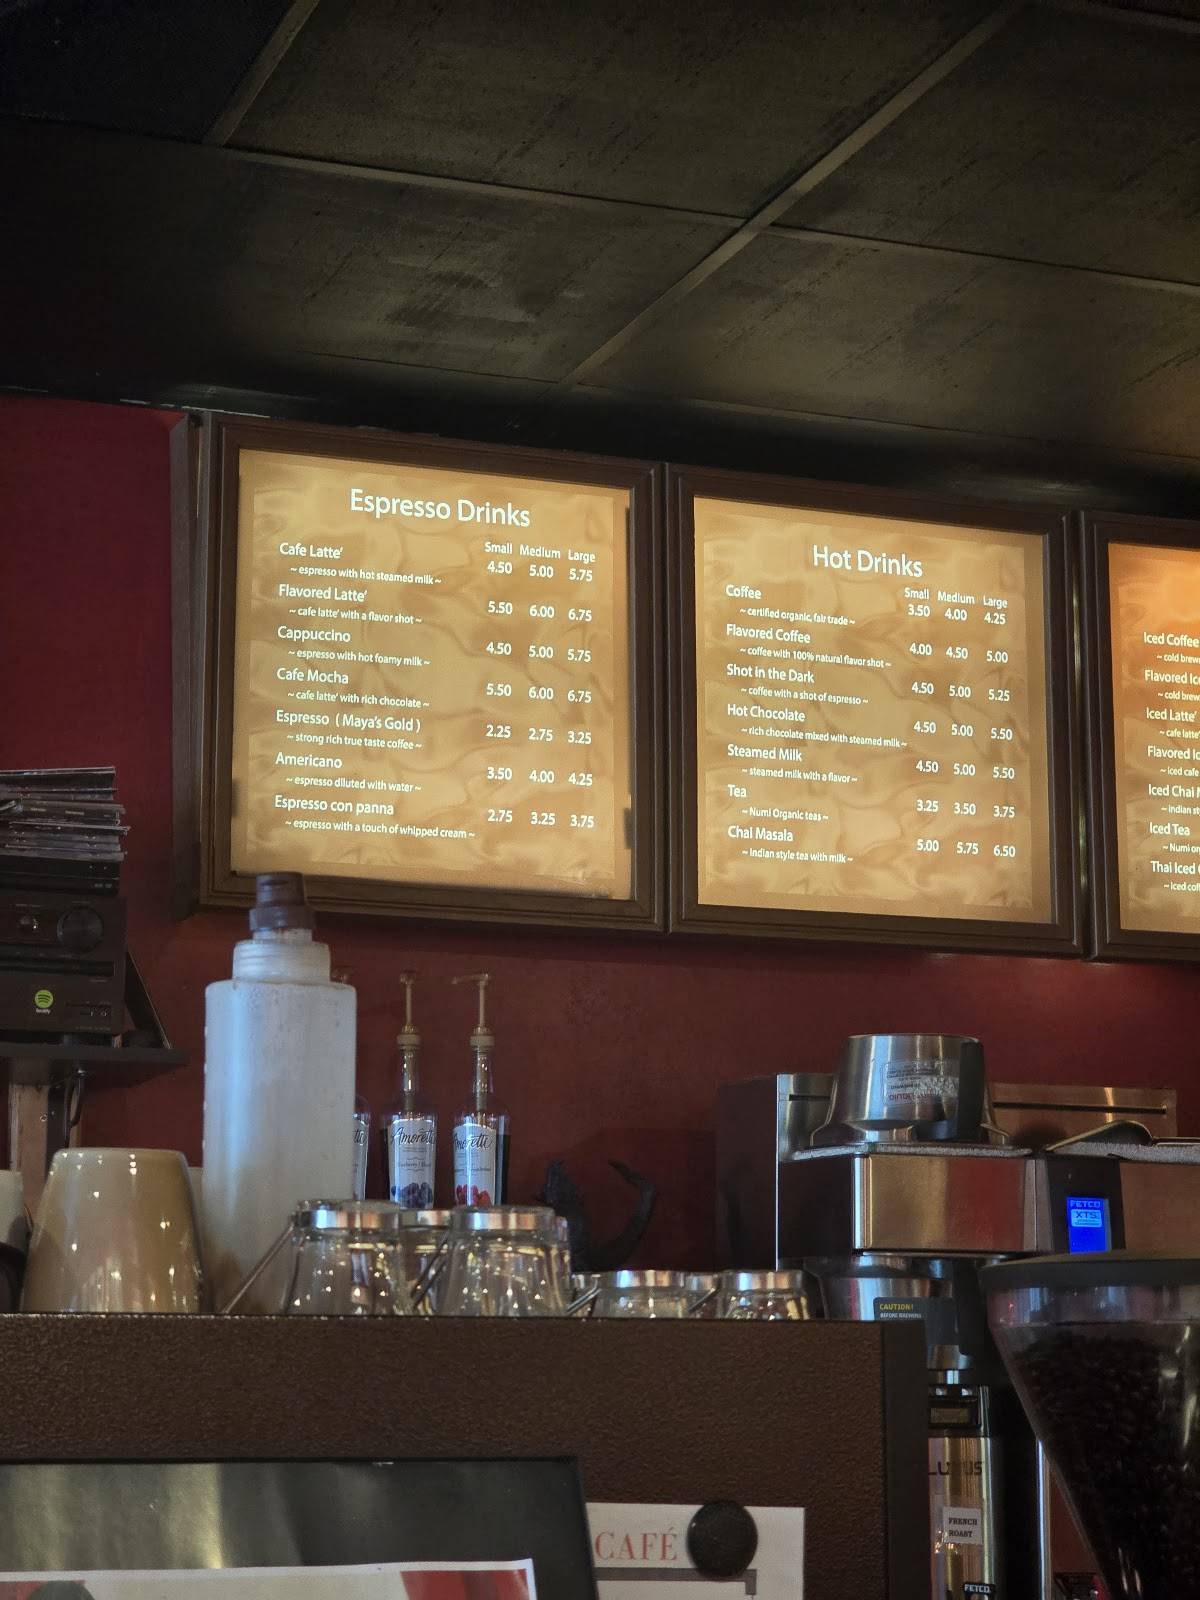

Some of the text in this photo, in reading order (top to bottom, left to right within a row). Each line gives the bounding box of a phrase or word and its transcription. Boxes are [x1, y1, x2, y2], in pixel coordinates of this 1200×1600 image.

[350, 488, 530, 527] Espresso Drinks
[279, 542, 307, 556] Cafe
[484, 541, 596, 564] Small Medium Large
[813, 544, 923, 578] Hot Drinks
[298, 566, 434, 585] espresso with hot steamed milk
[487, 560, 593, 582] 4.50 5.00 5.75
[278, 583, 332, 599] Flavored
[725, 584, 762, 600] Coffee
[904, 587, 1008, 609] Small Medium Large
[297, 606, 317, 617] cafe
[340, 610, 360, 620] with
[361, 612, 367, 621] a
[368, 611, 394, 623] flavor
[394, 613, 414, 625] shot
[488, 600, 592, 622] 5.50 6.00 6.75
[908, 604, 1006, 625] 3.50 4.00 4.25
[277, 625, 351, 643] Cappuccino
[726, 623, 811, 644] Flavored Coffee
[1143, 631, 1200, 648] Iced Coffee
[296, 650, 423, 667] espresso with hot foamy milk
[486, 641, 591, 662] 4.50 5.00 5.75
[793, 650, 815, 661] 100%
[909, 642, 1009, 663] 4.00 4.50 5.00
[276, 667, 349, 684] Cafe Mocha
[726, 663, 815, 683] Shot in the Dark
[1144, 669, 1188, 684] Flavored
[295, 690, 315, 700] cafe
[339, 693, 360, 703] with
[361, 694, 378, 705] rich
[378, 695, 422, 708] chocolate
[486, 683, 592, 704] 5.50 6.00 6.75
[911, 681, 1010, 702] 4.50 5.00 5.25
[276, 709, 330, 726] Espresso
[384, 717, 414, 732] Gold
[727, 703, 806, 722] Hot Chocolate
[1146, 707, 1167, 720] Iced
[486, 724, 592, 745] 2.25 2.75 3.25
[913, 721, 1013, 741] 4.50 5.00 5.50
[295, 733, 414, 750] strong rich true taste coffee
[275, 751, 343, 769] Americano
[727, 743, 802, 762] Steamed Milk
[1147, 745, 1191, 760] Flavored
[487, 766, 593, 787] 3.50 4.00 4.25
[915, 760, 1015, 780] 4.50 5.00 5.50
[727, 784, 747, 798] Tea
[1148, 783, 1195, 798] Iced Chai
[275, 794, 394, 816] Espresso con panna
[916, 799, 1015, 818] 3.25 3.50 3.75
[487, 809, 595, 828] 2.75 3.25 3.75
[293, 820, 467, 839] espresso with a touch of whipped cream
[727, 825, 793, 842] Chai Masala
[1149, 822, 1191, 836] Iced Tea
[916, 838, 1016, 858] 5.00 5.75 6.50
[1150, 860, 1196, 875] Thai Iced
[948, 1517, 978, 1526] FRENCH
[948, 1530, 973, 1538] ROAST
[594, 1527, 678, 1561] CAFÉ
